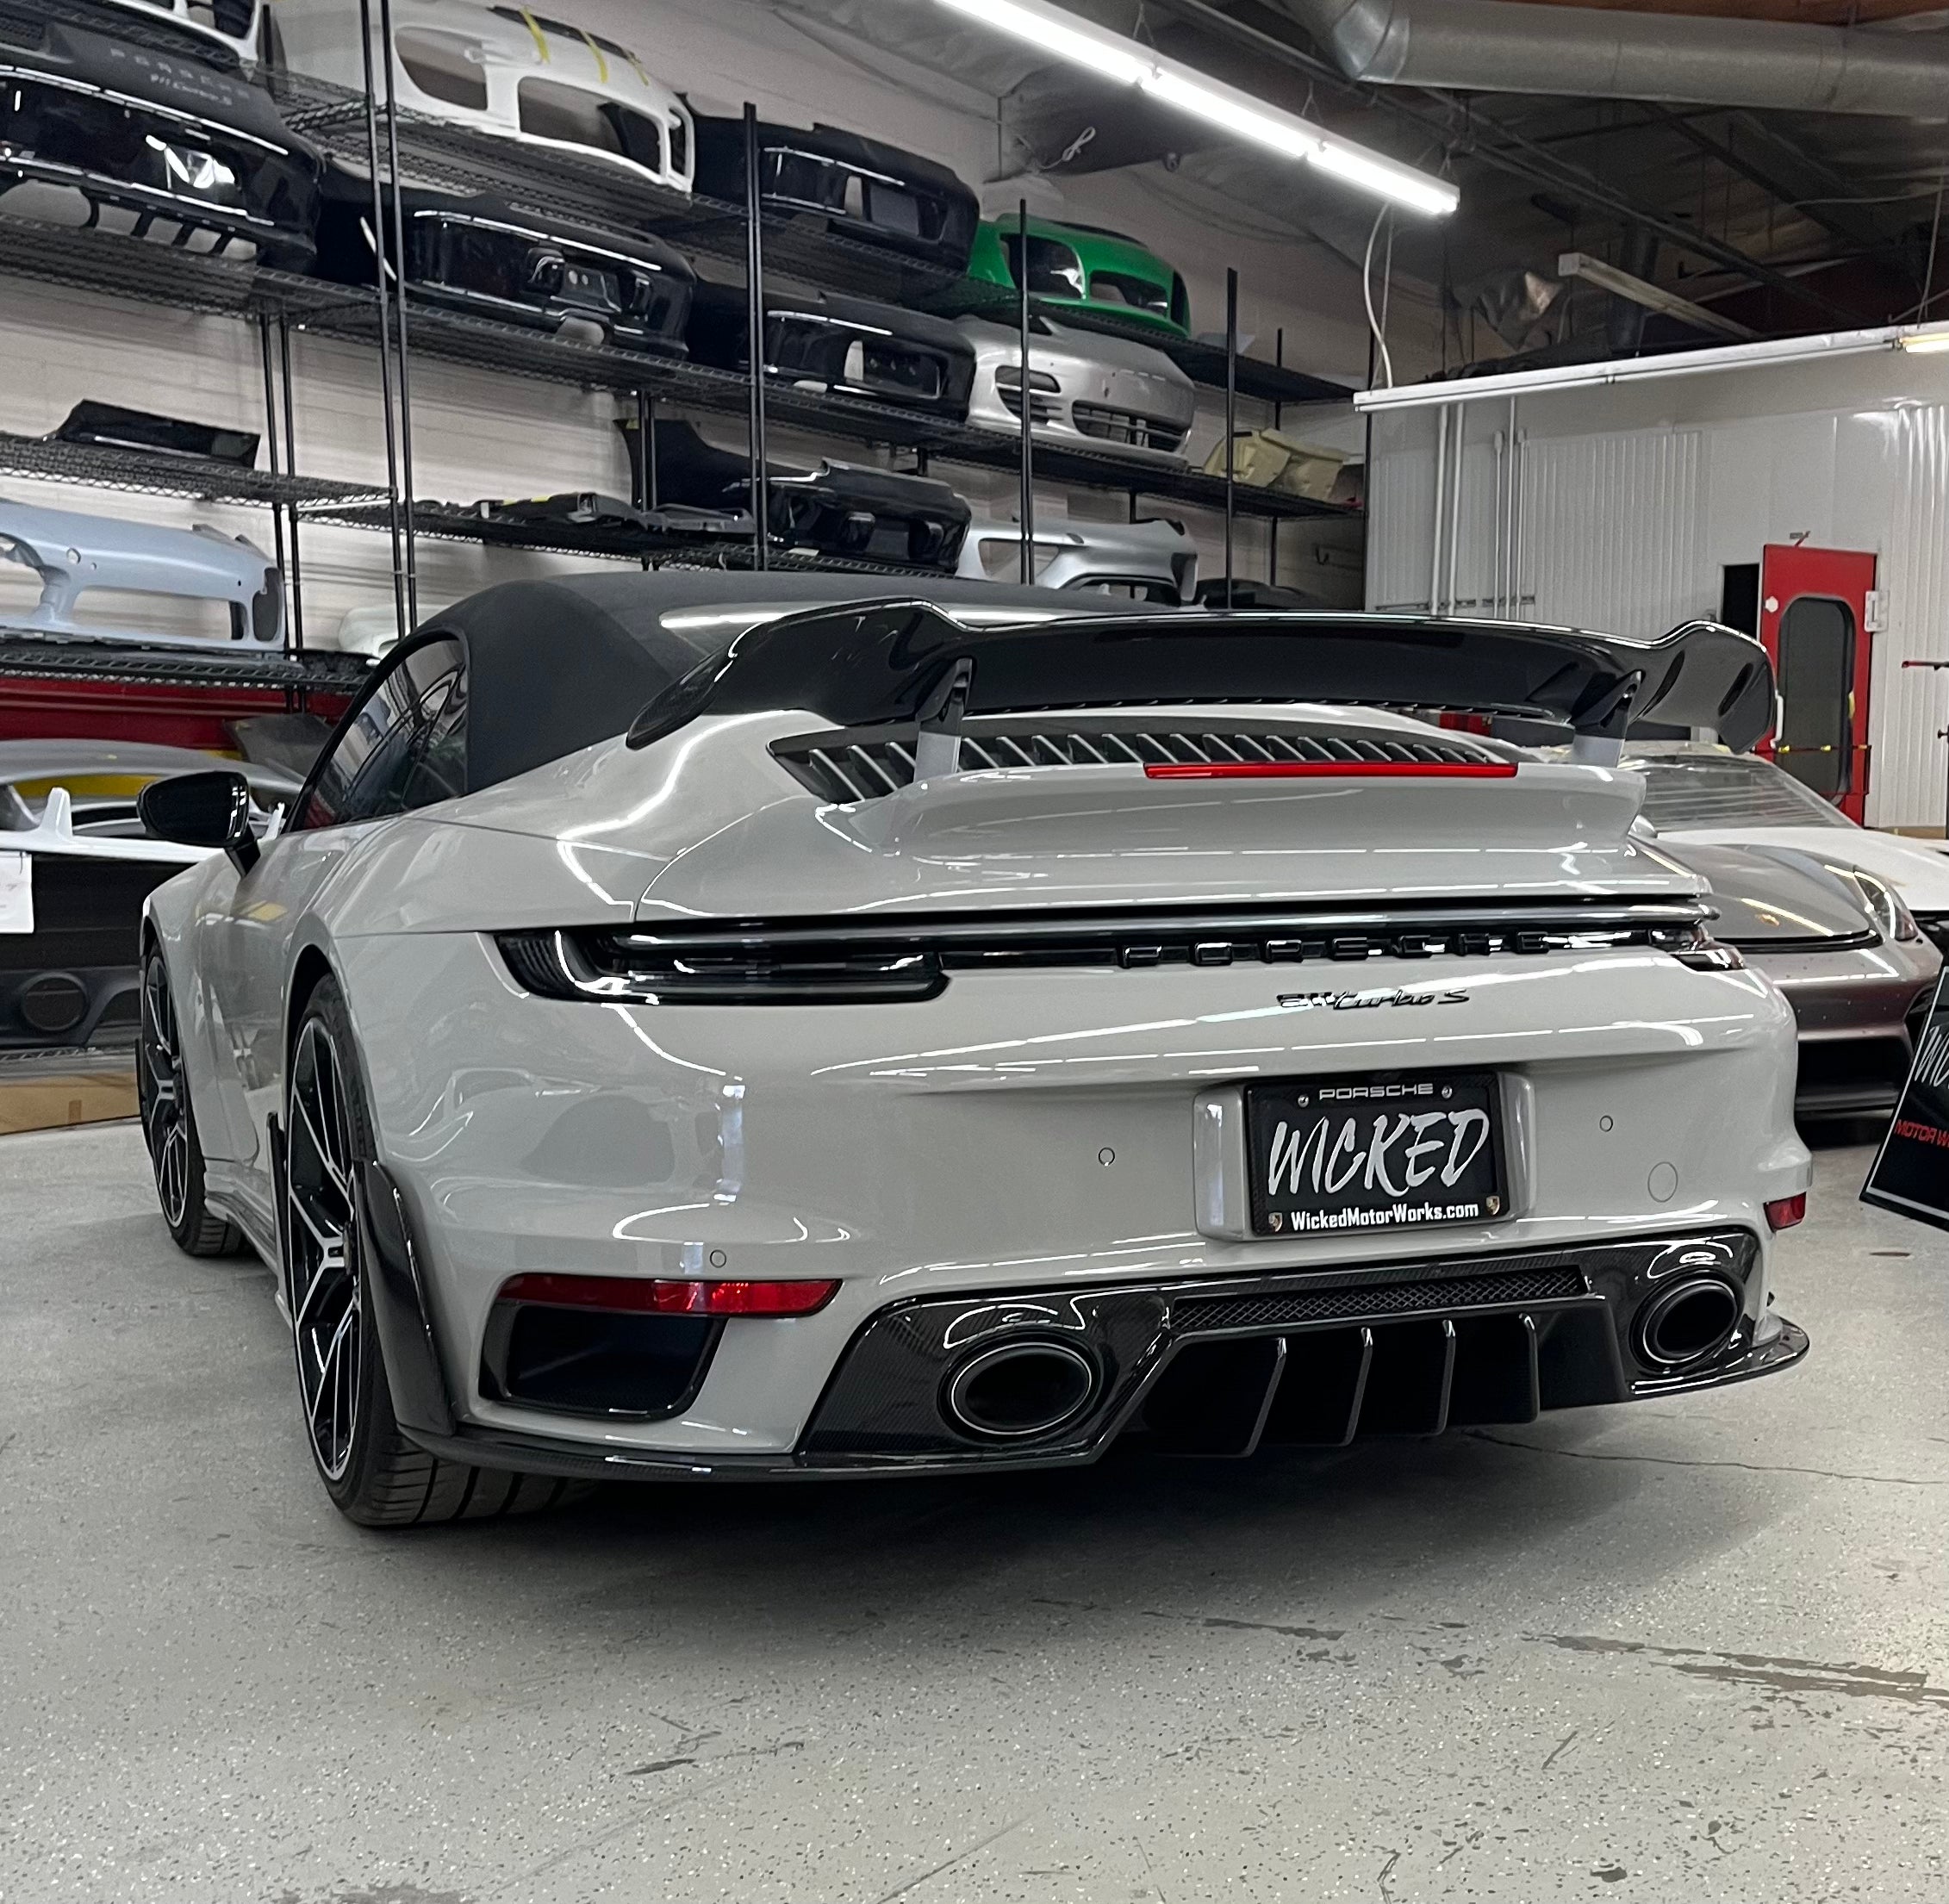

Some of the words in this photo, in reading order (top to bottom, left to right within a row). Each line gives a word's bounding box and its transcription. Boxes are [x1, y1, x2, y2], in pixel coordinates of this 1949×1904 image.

[1119, 931, 1550, 968] PORSCHE
[1438, 990, 1470, 1005] S
[1319, 1083, 1434, 1100] PORSCHE
[1267, 1109, 1490, 1198] WICKED
[1291, 1202, 1479, 1231] WickedMotorWorks.com
